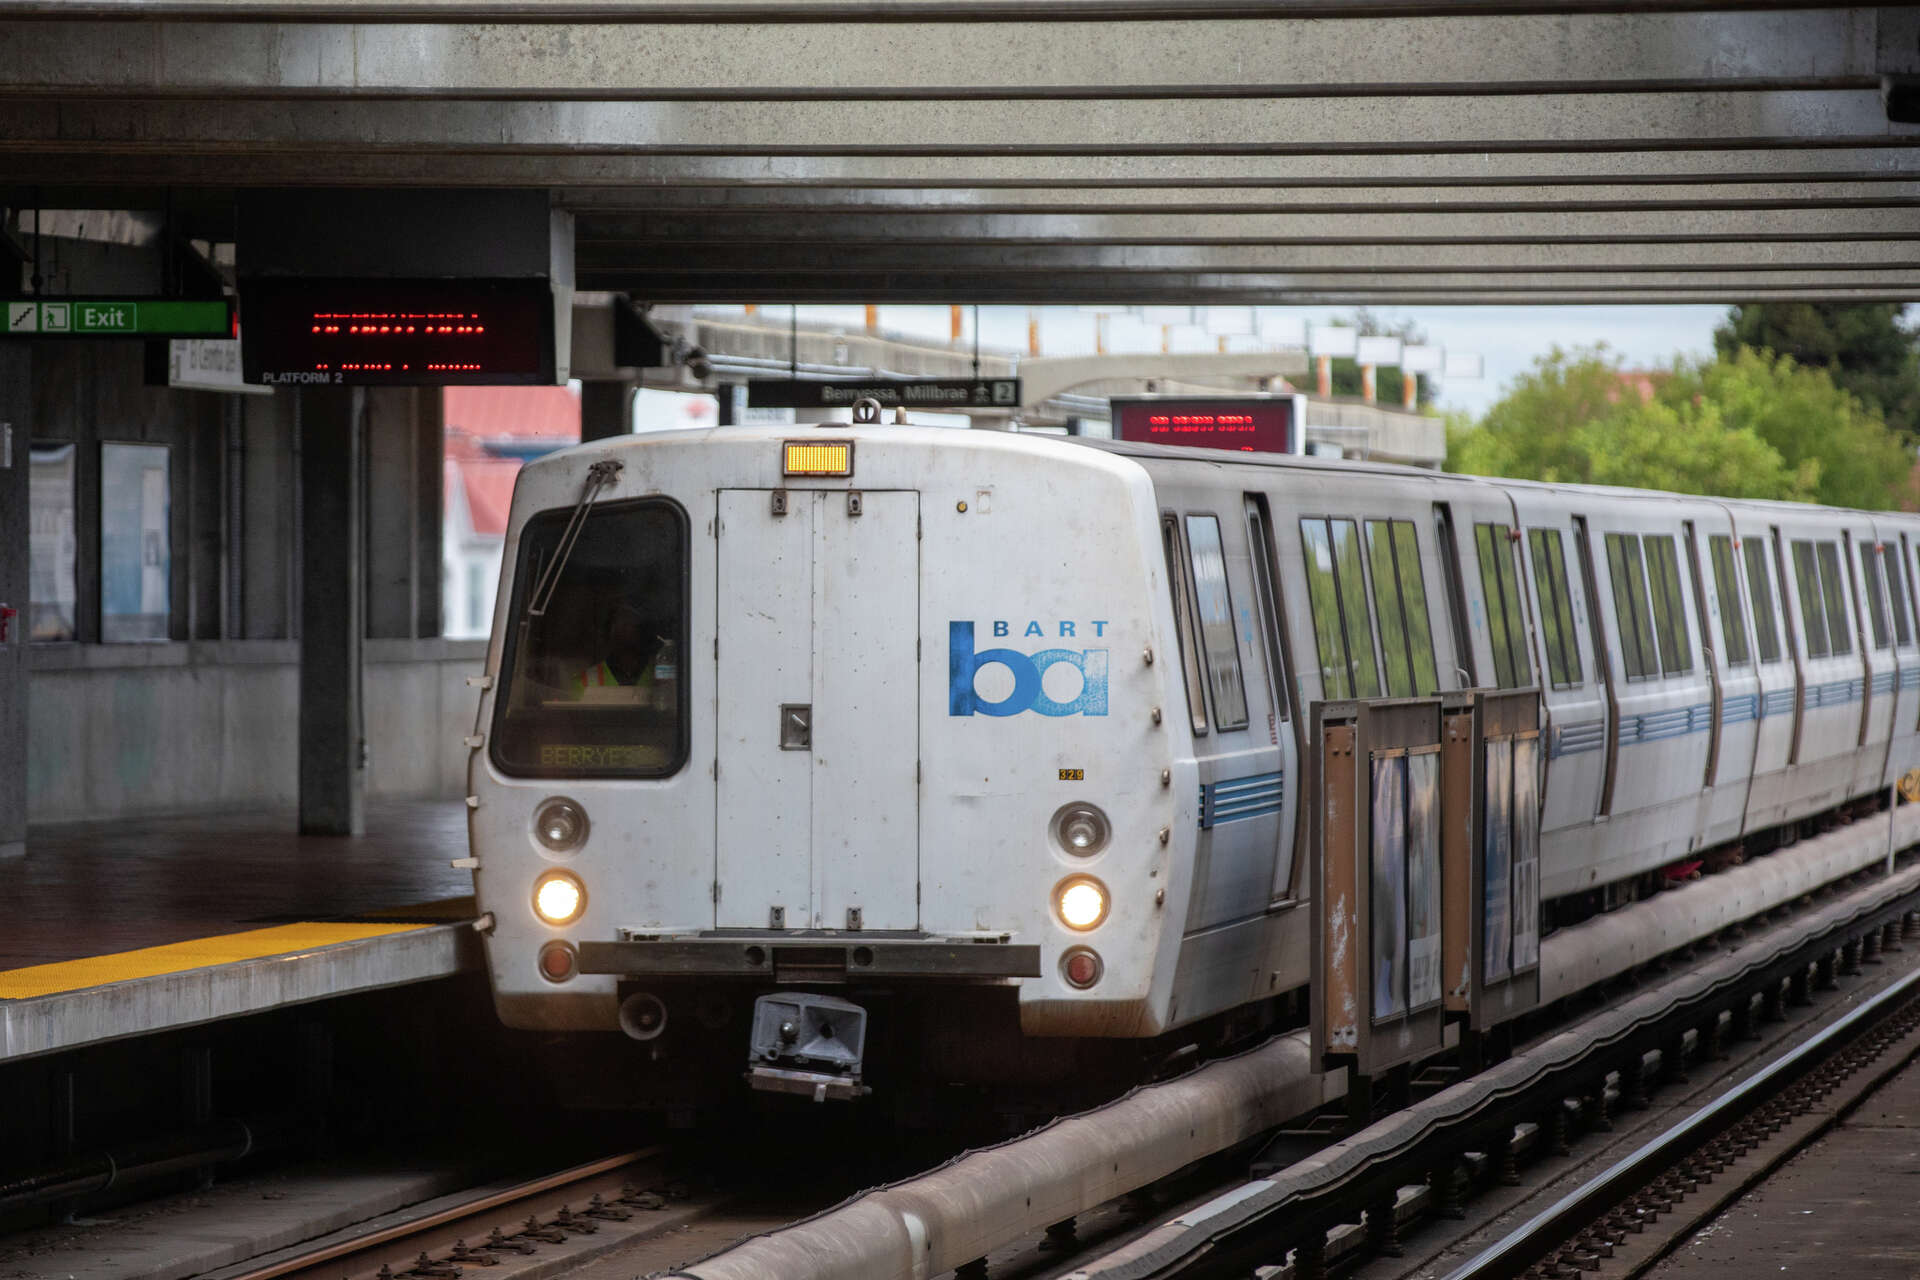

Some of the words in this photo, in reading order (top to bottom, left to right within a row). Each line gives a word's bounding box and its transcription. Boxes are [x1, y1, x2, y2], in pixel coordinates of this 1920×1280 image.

[84, 308, 124, 327] Exit
[263, 372, 330, 383] PLATFORM
[335, 372, 343, 383] 2
[906, 385, 968, 400] Millbrae
[994, 621, 1108, 637] BART
[1059, 769, 1083, 780] 329
